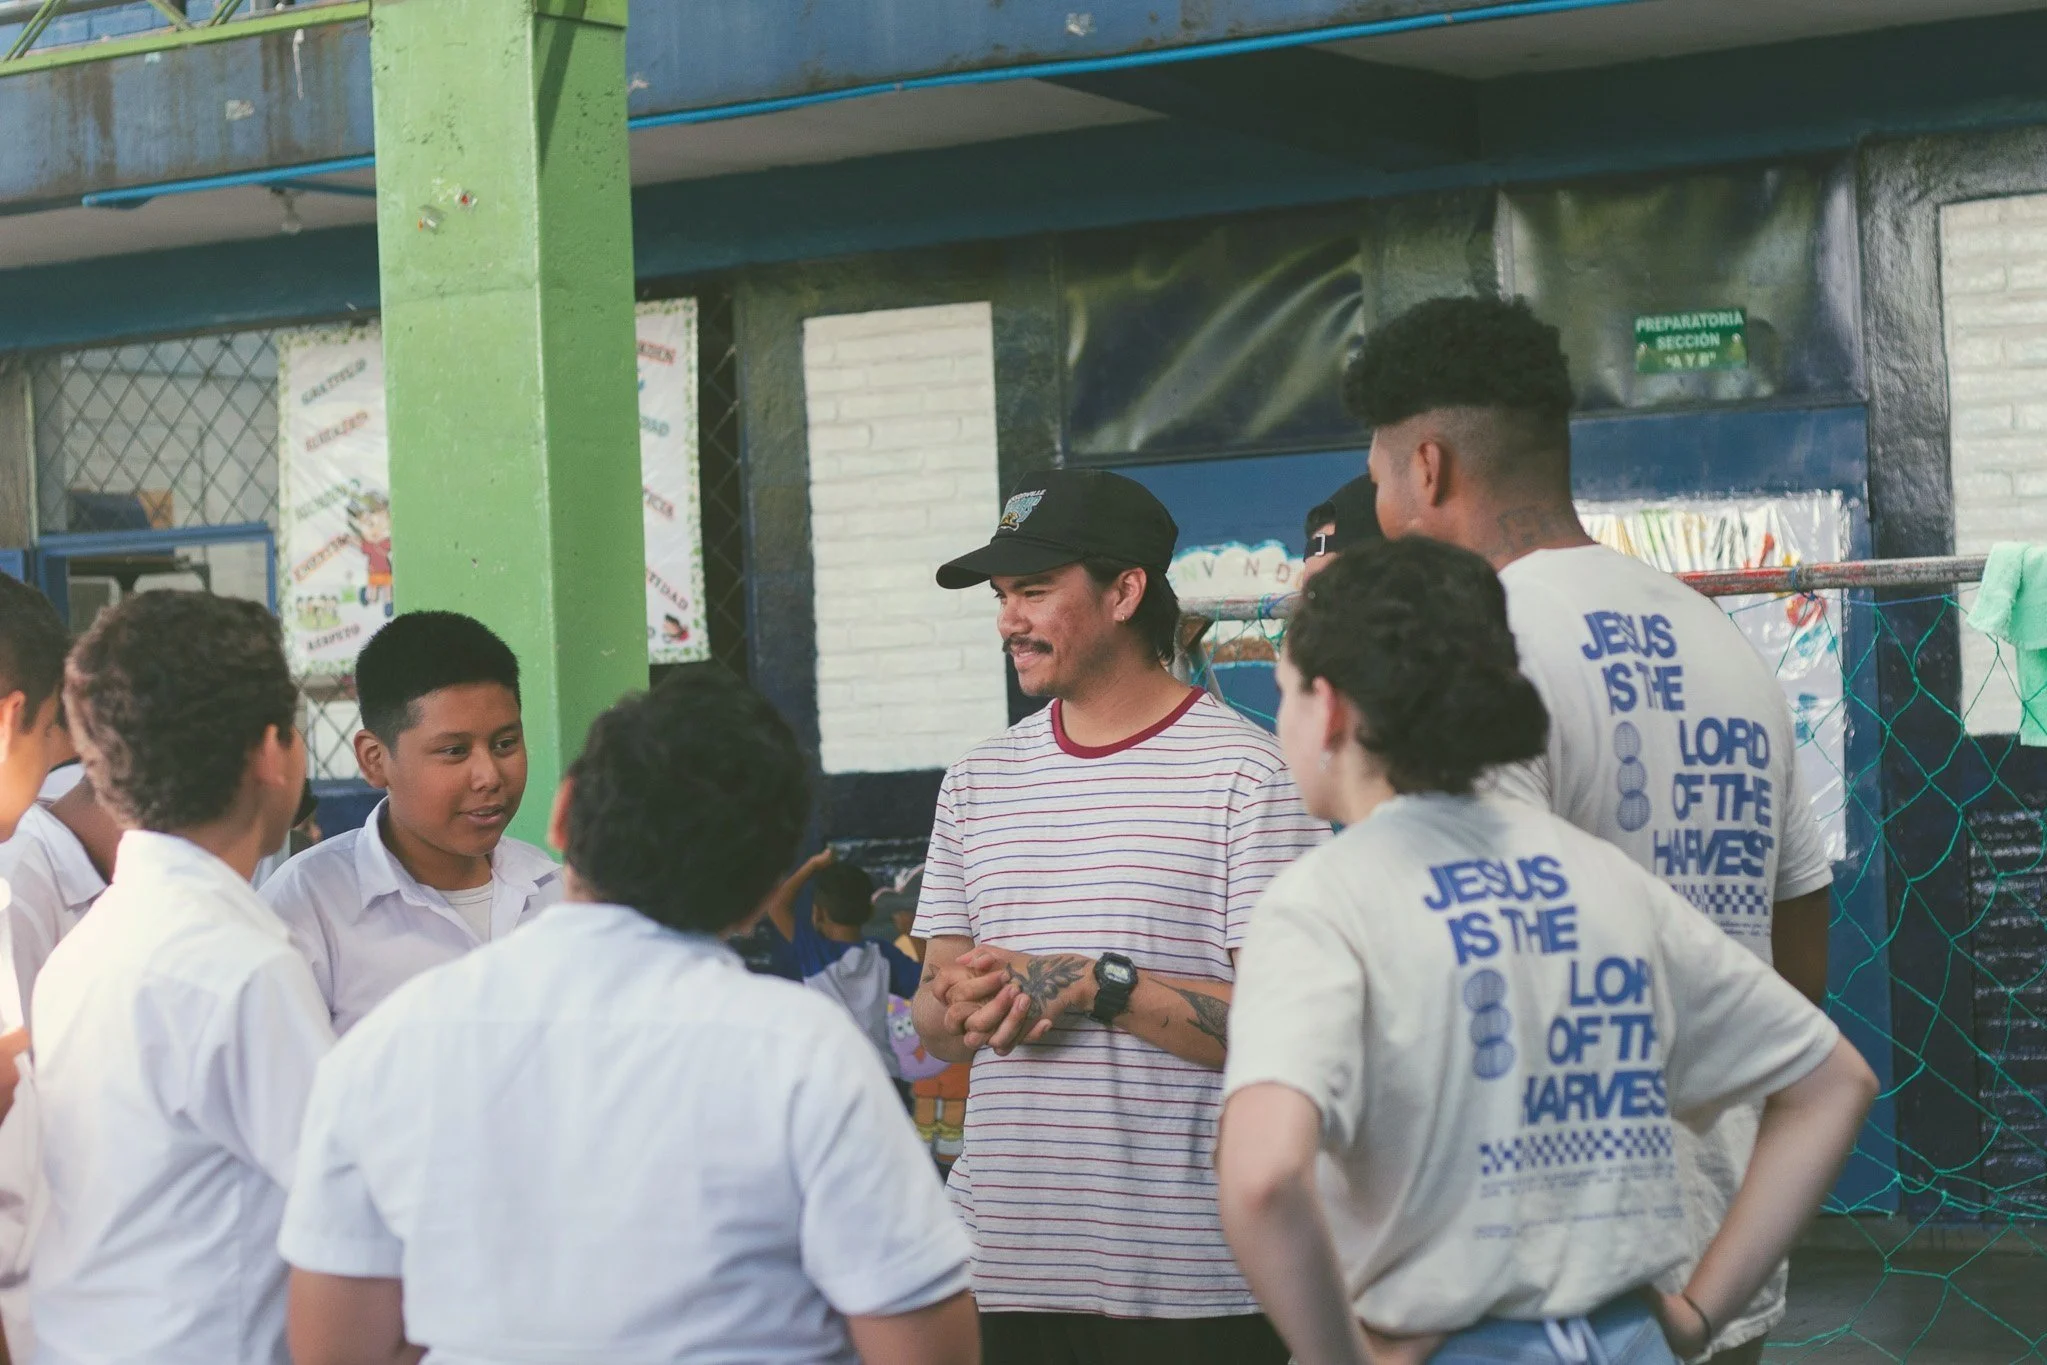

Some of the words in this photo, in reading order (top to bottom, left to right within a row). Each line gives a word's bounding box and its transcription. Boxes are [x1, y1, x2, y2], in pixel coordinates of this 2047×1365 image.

[1635, 311, 1744, 332] PREPARATORIA
[1656, 331, 1721, 350] SECCIÓN
[1581, 611, 1677, 661] JESUS
[1601, 662, 1638, 716] IS
[1635, 661, 1686, 712] THE
[1679, 717, 1771, 770] LORD
[1673, 773, 1706, 822] OF
[1709, 773, 1773, 829] THE
[1424, 855, 1568, 911] JESUS
[1448, 912, 1501, 966] IS
[1498, 905, 1577, 955] THE
[1547, 1015, 1604, 1067] OF
